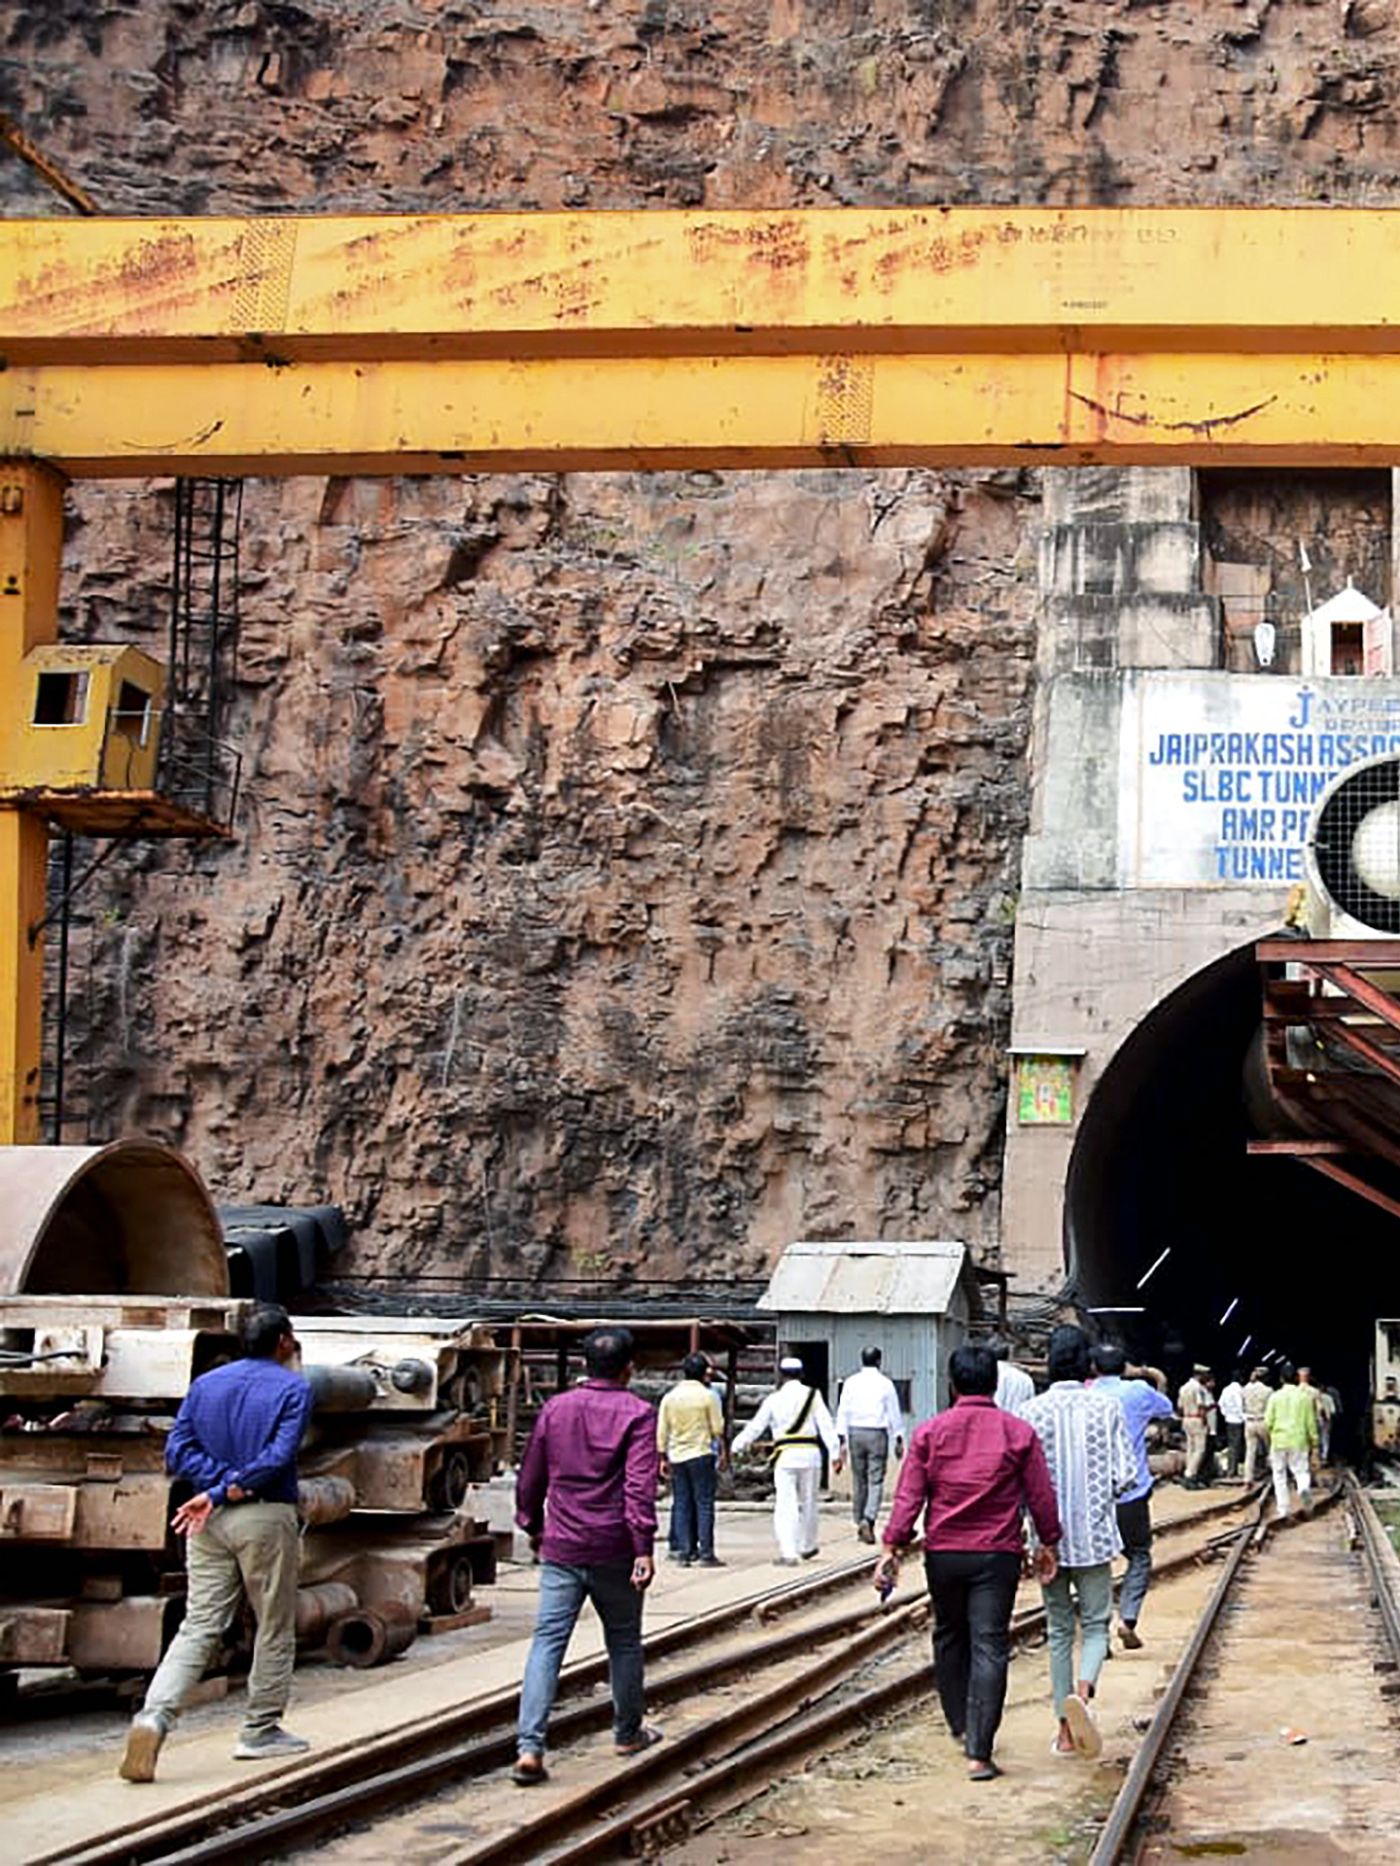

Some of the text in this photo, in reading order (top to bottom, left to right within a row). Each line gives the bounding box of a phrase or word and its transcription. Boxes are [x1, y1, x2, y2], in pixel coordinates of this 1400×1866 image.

[1149, 733, 1314, 766] JAIPRAKASH
[1183, 770, 1338, 804] SLBC TUNN
[1222, 808, 1275, 841] AMR
